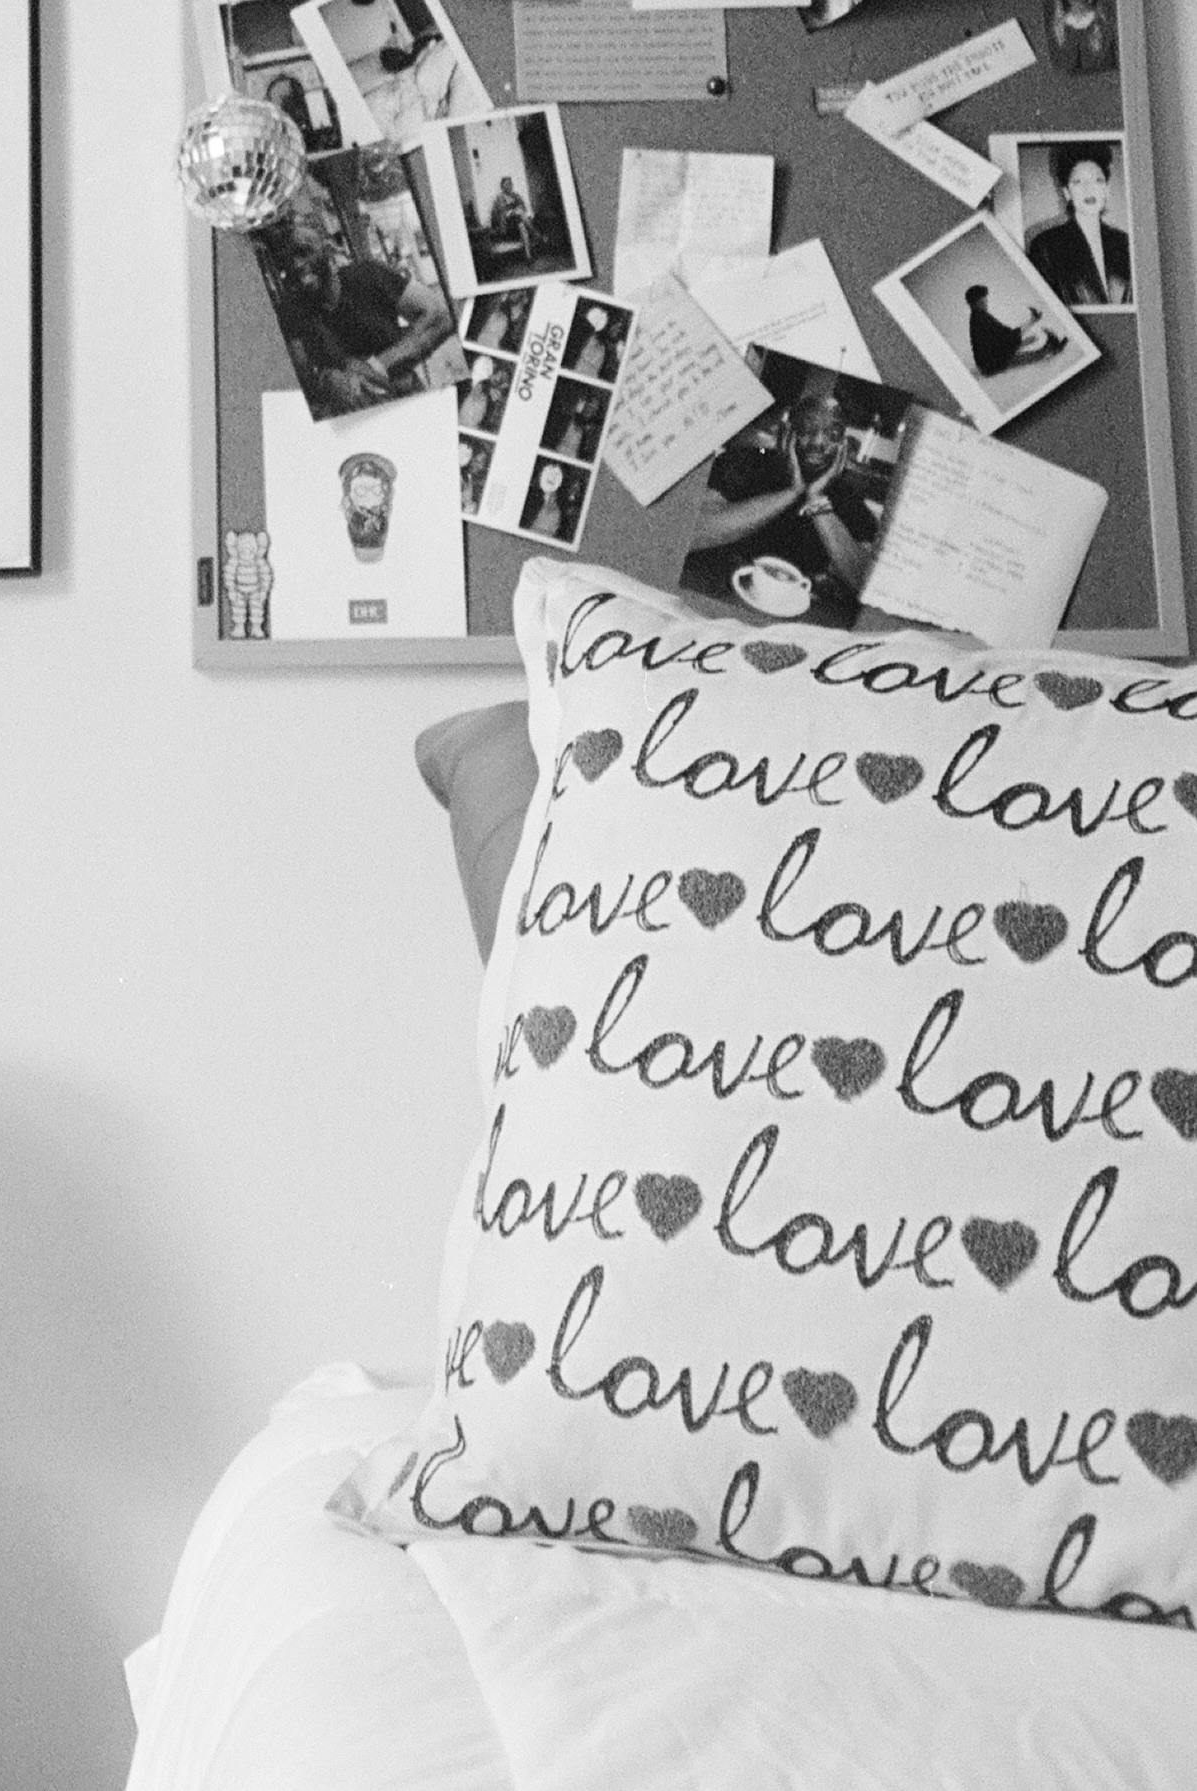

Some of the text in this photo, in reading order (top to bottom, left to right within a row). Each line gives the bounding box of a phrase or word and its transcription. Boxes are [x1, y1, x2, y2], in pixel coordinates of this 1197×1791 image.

[519, 332, 548, 402] TORINO
[540, 323, 566, 380] GRAN
[631, 687, 849, 806] love
[932, 723, 1167, 837] love
[516, 821, 672, 936] love
[756, 827, 986, 967] love
[585, 954, 809, 1100] love
[896, 988, 1144, 1142] love
[474, 1102, 628, 1242] love
[713, 1124, 954, 1287] love
[547, 1264, 780, 1434] love
[872, 1315, 1120, 1486] love
[410, 1414, 629, 1543] love
[718, 1461, 944, 1595] love
